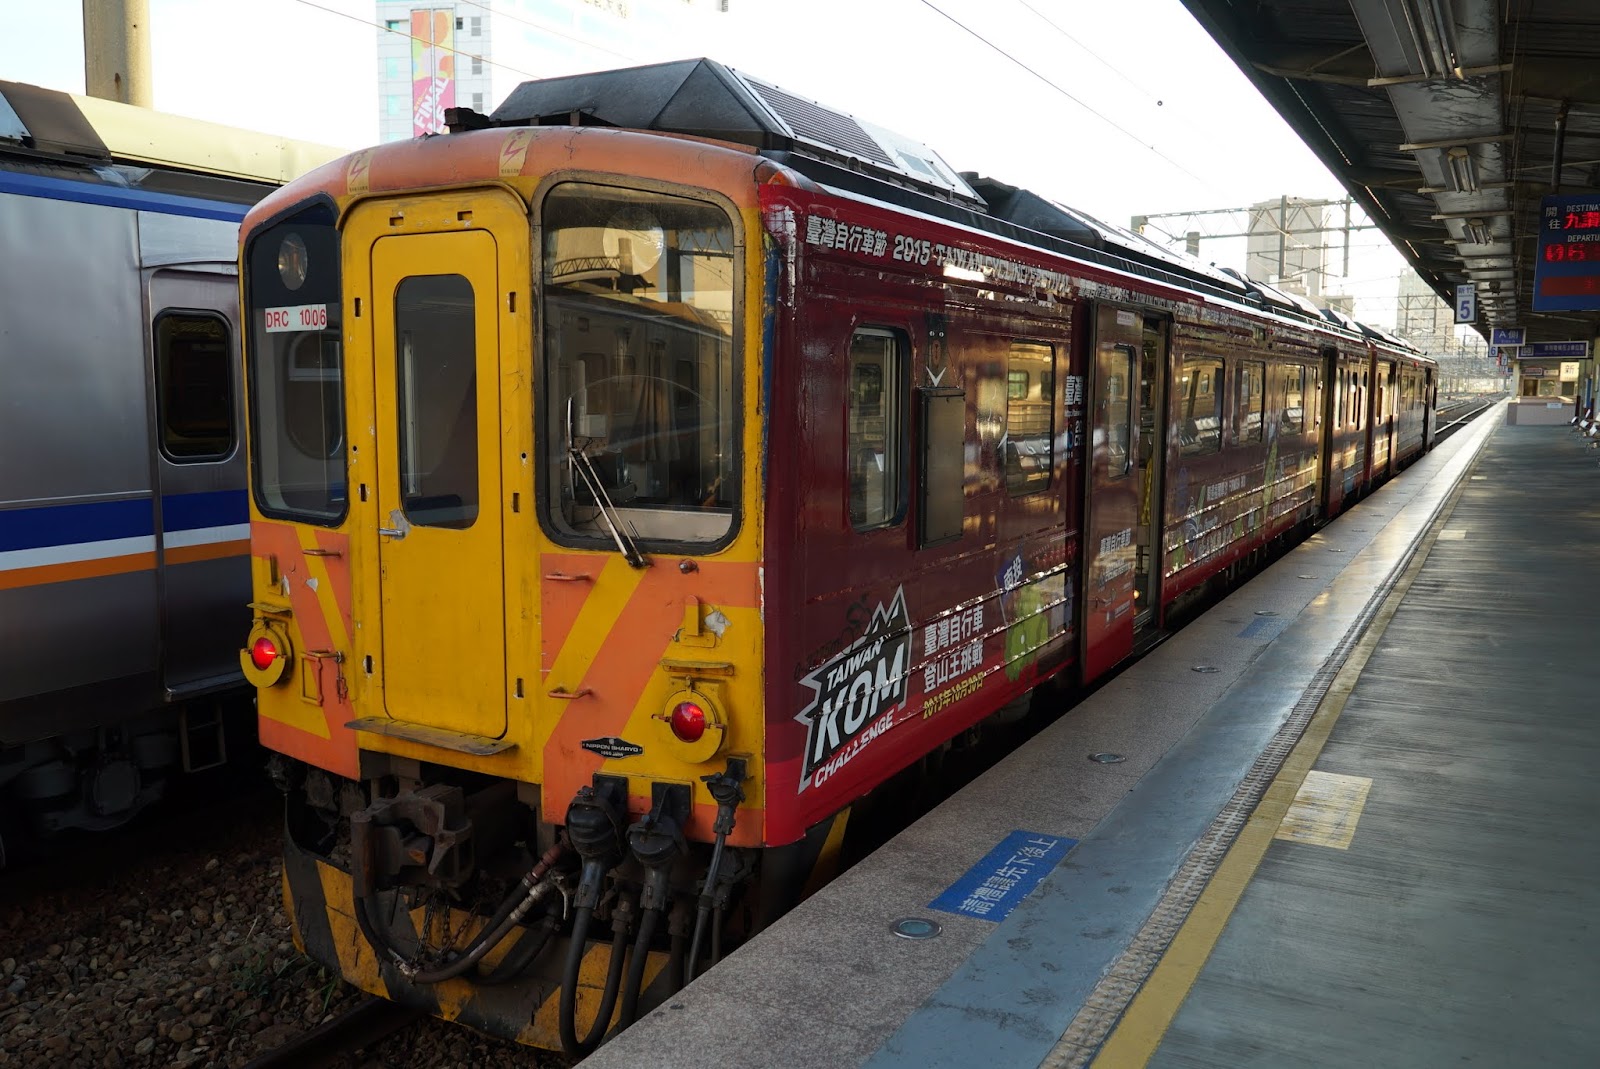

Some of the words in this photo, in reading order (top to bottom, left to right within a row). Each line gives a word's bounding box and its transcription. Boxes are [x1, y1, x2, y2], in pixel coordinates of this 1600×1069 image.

[413, 77, 449, 128] FINAL
[1563, 212, 1600, 229] 九讚
[1566, 203, 1600, 213] DESTINA
[806, 215, 888, 258] 臺灣自行車節
[893, 234, 931, 266] 2015
[266, 310, 289, 328] DRC
[300, 308, 326, 326] 1006
[1460, 300, 1471, 320] 5
[1498, 330, 1507, 338] A
[1490, 346, 1497, 356] 6
[924, 604, 984, 657] 臺灣自行車
[826, 638, 884, 692] TAIWAN
[924, 639, 983, 694] 登山王挑戰
[813, 642, 905, 765] KOM
[814, 709, 895, 789] CHALLENGE
